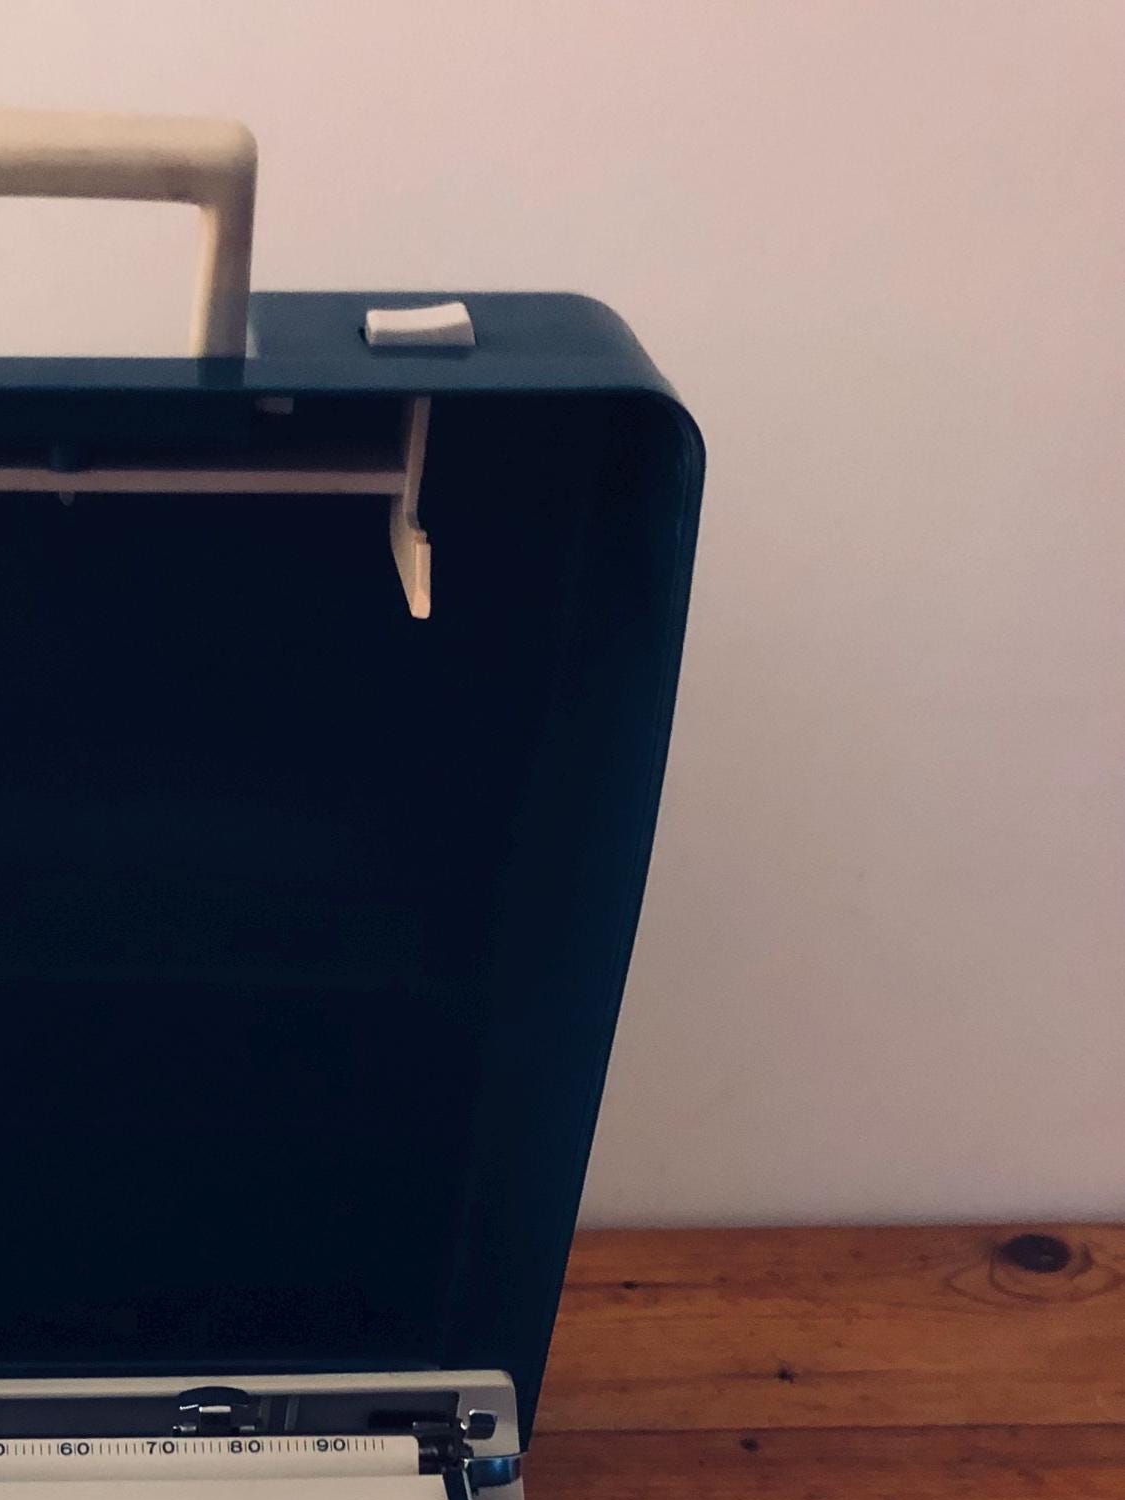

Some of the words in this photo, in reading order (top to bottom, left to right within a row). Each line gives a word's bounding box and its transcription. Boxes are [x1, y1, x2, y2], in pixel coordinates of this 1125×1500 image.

[60, 1442, 91, 1457] 60
[147, 1441, 176, 1456] 70
[230, 1440, 262, 1455] 80
[316, 1438, 347, 1453] 90
